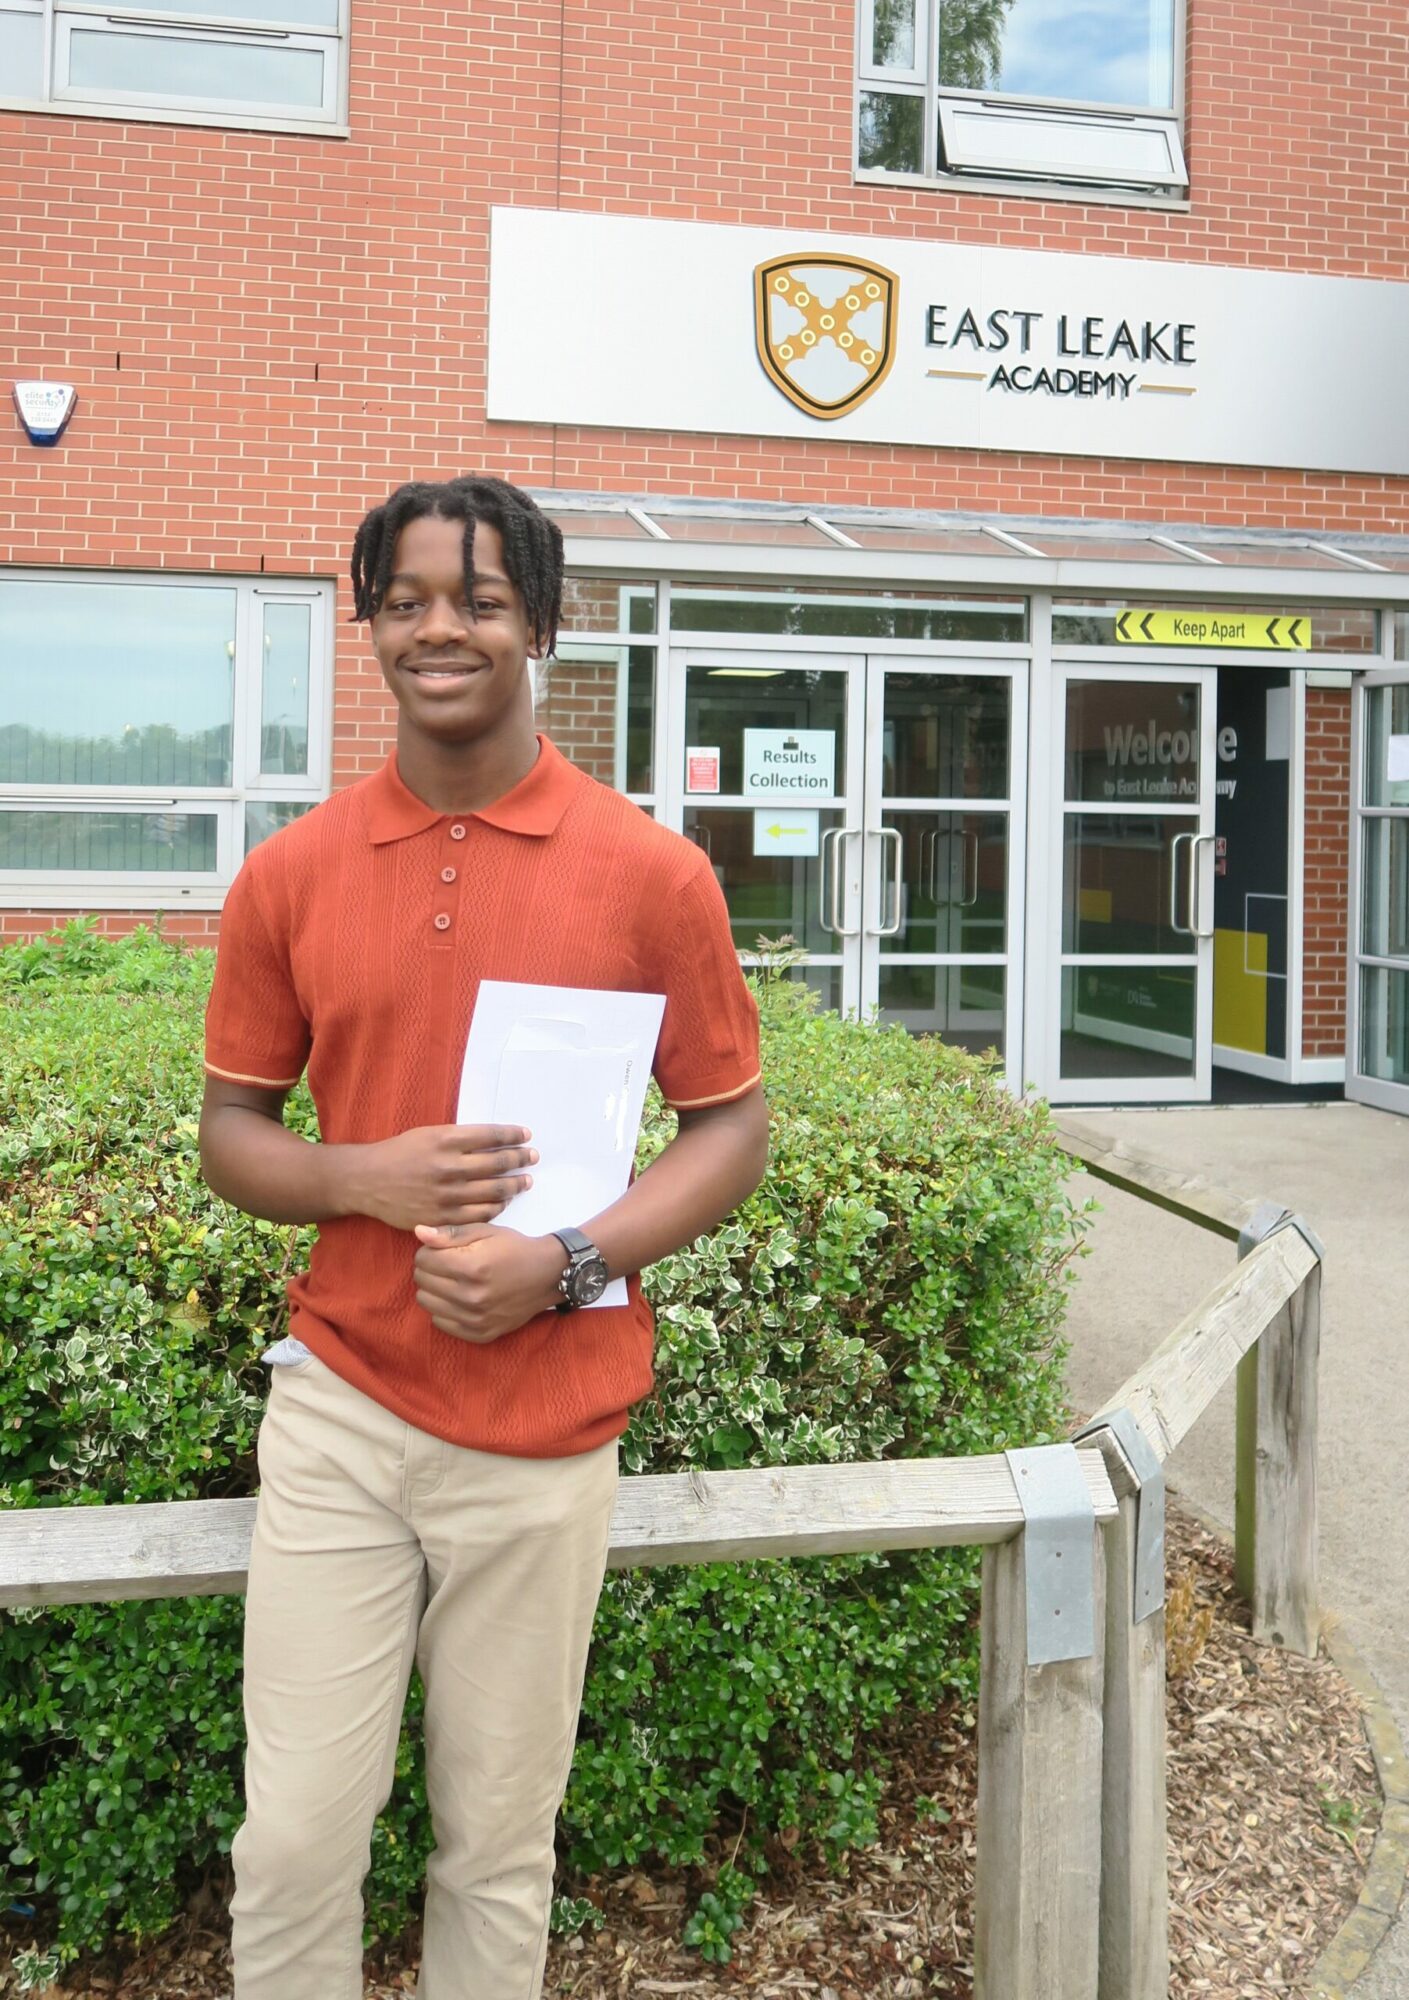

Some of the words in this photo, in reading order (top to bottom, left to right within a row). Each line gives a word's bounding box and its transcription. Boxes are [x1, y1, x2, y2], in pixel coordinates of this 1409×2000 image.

[926, 304, 1043, 352] EAST
[1058, 314, 1196, 364] LEAKE
[988, 364, 1137, 397] ACADEMY
[1174, 619, 1207, 641] Keep
[1211, 620, 1245, 642] Apart
[763, 750, 817, 764] Results
[750, 772, 828, 788] Collection
[1143, 776, 1178, 796] Leake
